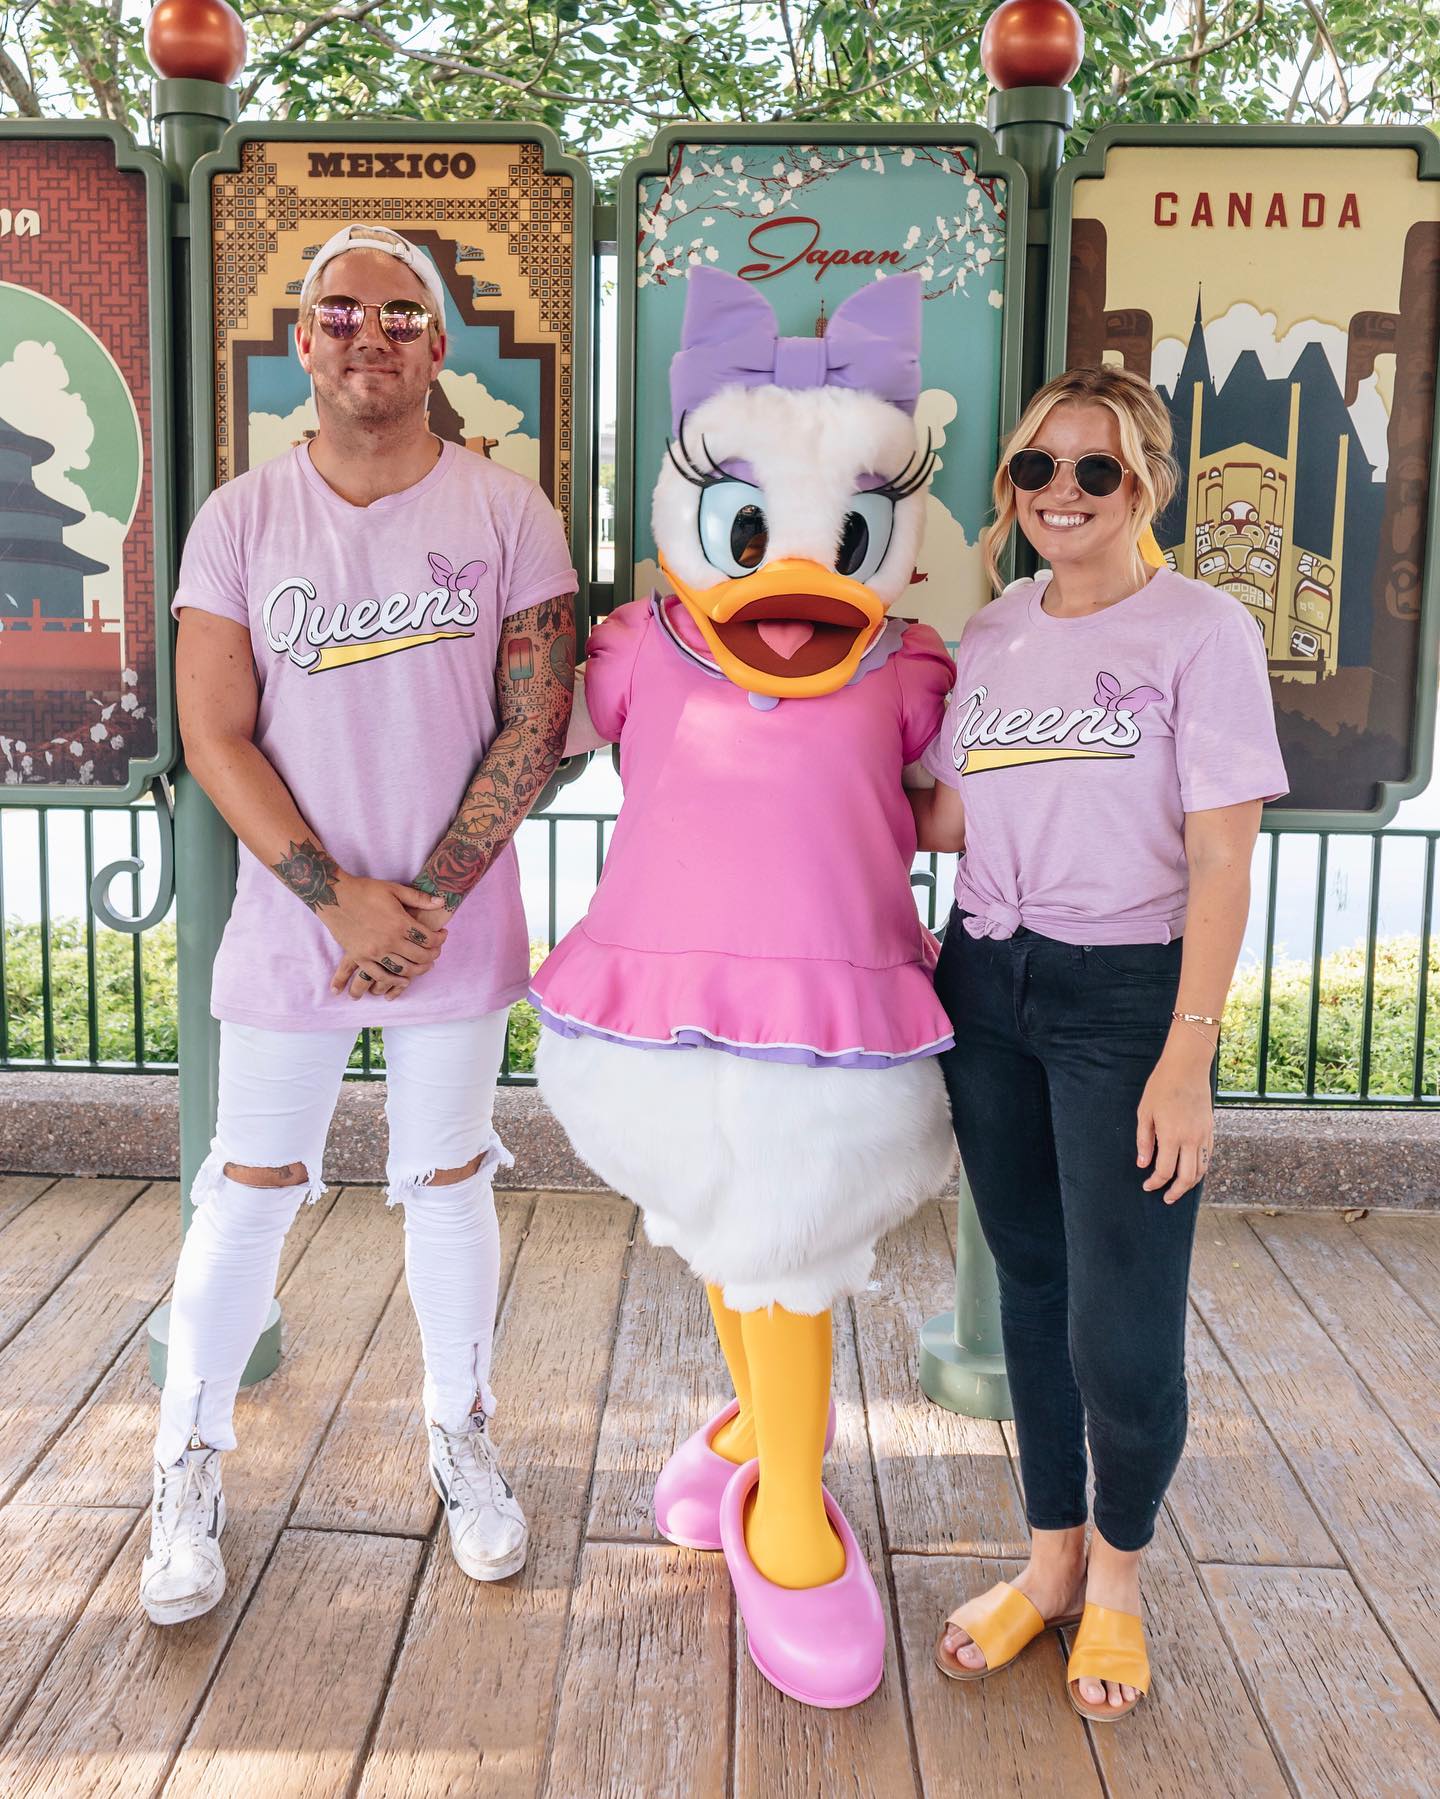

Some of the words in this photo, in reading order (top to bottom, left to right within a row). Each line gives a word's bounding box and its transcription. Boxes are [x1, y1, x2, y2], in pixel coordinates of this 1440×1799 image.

[308, 152, 476, 179] MEXICO
[1154, 192, 1361, 228] CANADA
[737, 216, 907, 281] Japan
[262, 577, 479, 668] Queens
